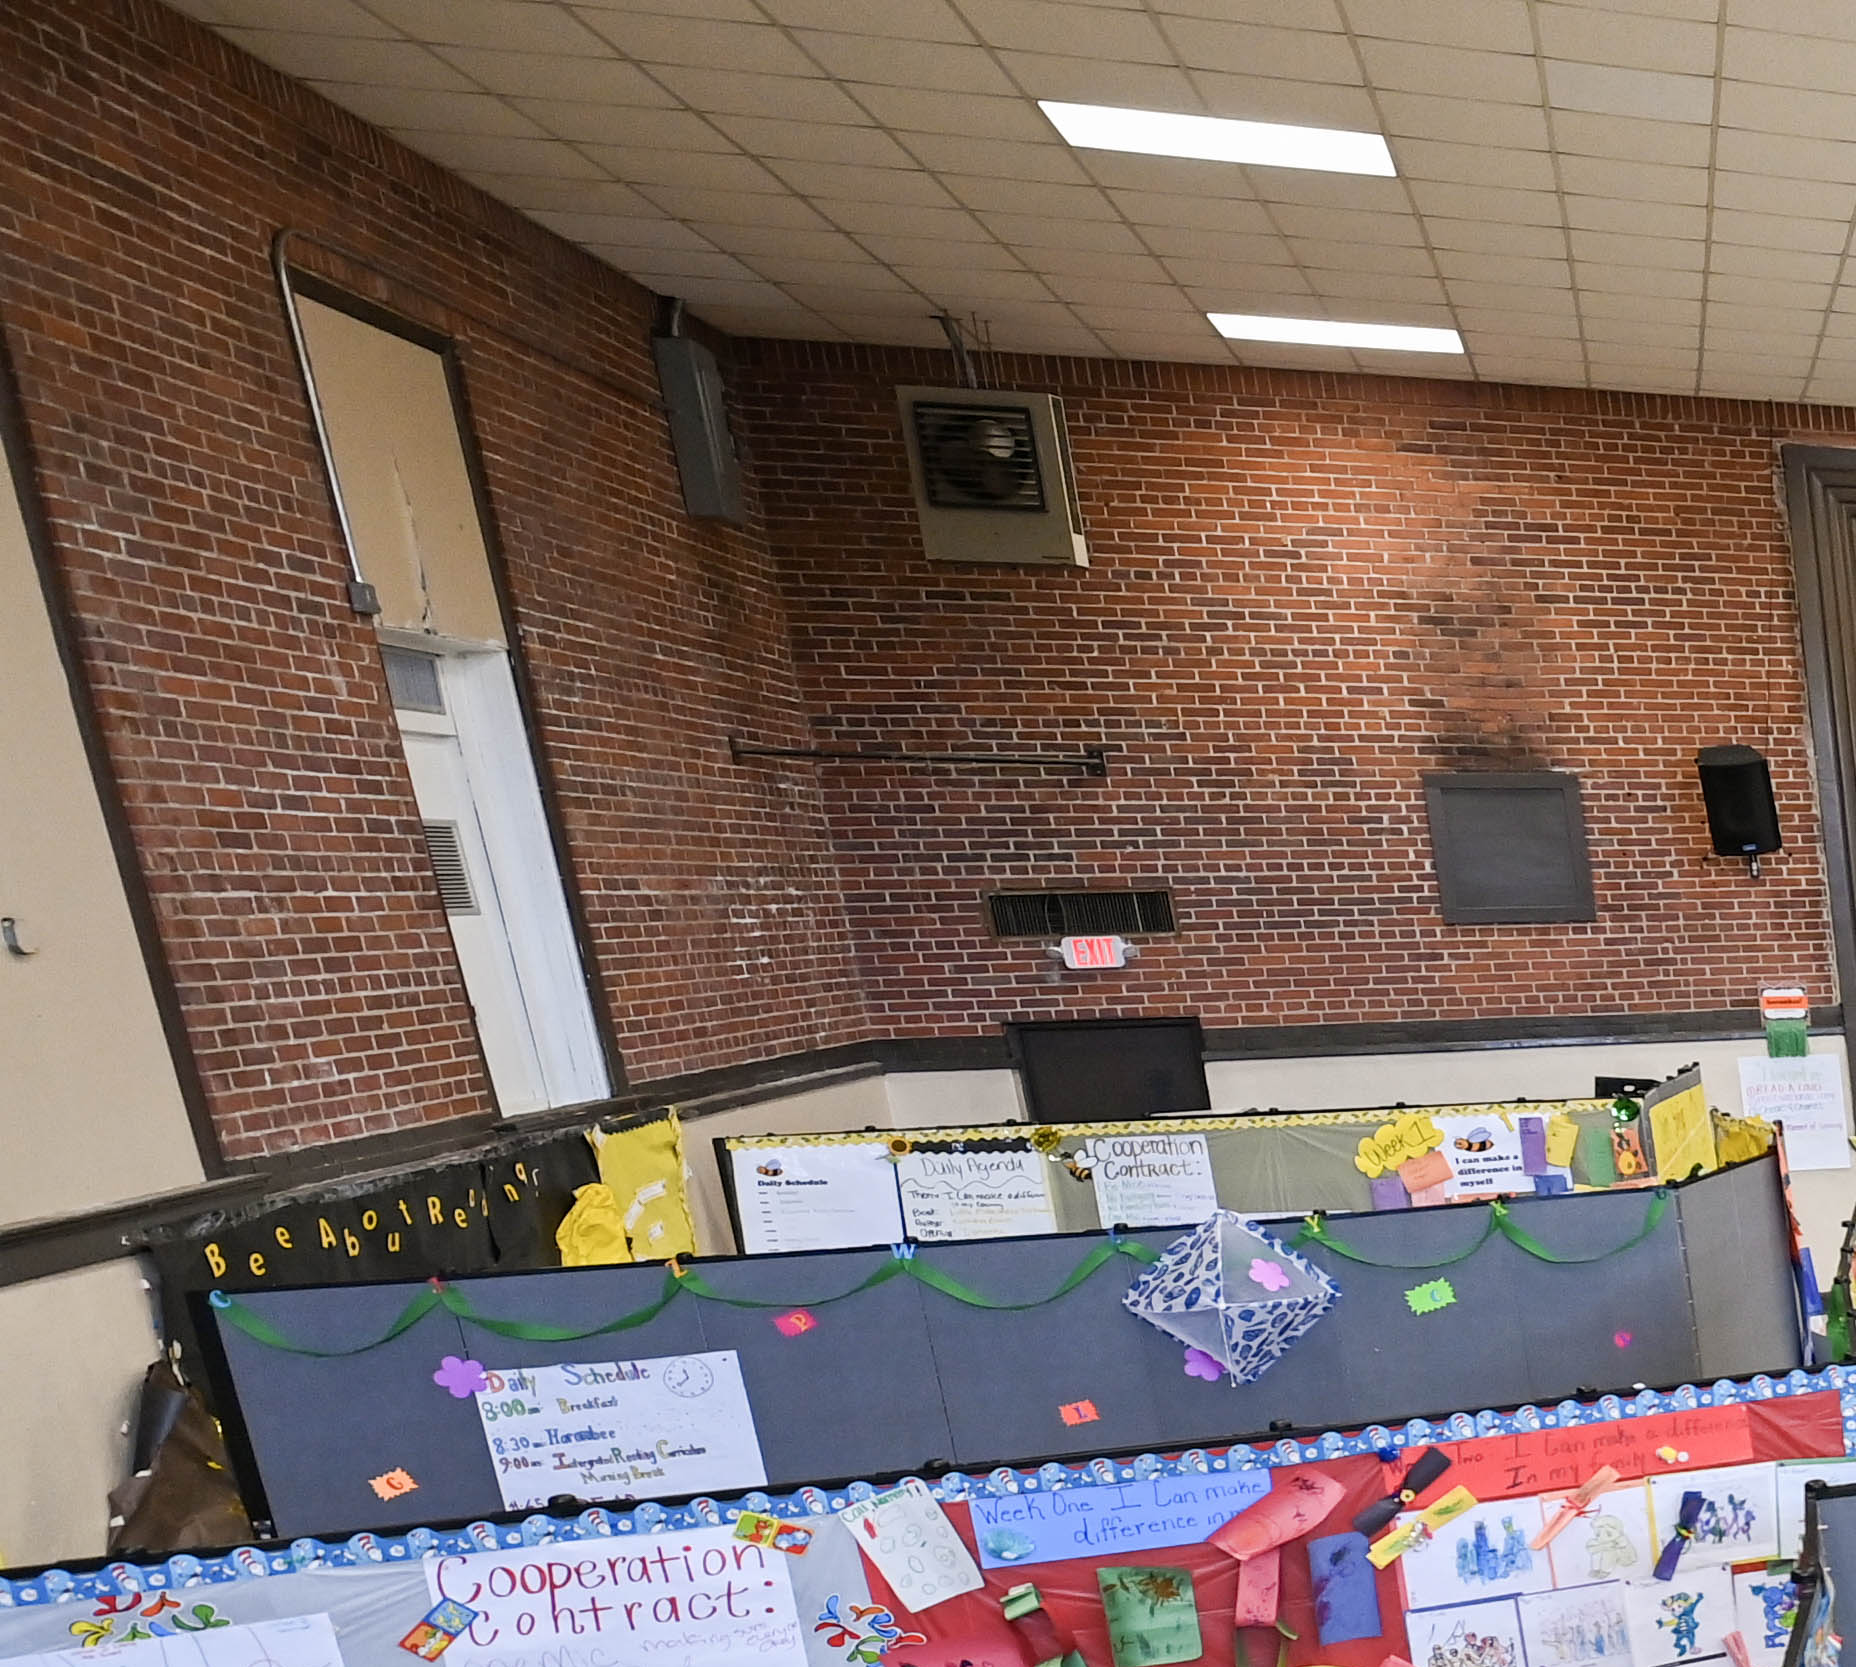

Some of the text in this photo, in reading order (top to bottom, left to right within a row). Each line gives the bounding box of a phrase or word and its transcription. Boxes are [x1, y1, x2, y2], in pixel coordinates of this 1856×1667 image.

[1072, 937, 1116, 966] EXIT
[1093, 1137, 1204, 1164] Cooperation
[1364, 1135, 1405, 1167] Week
[921, 1156, 1025, 1180] Daily Agenda
[204, 1226, 293, 1278] Bee
[318, 1199, 413, 1257] About
[487, 1362, 651, 1397] Daily Schedule
[556, 1395, 619, 1414] Breakfast
[976, 1479, 1265, 1524] Week One I Can make
[1073, 1515, 1198, 1547] difference
[438, 1544, 765, 1605] Cooperation
[469, 1580, 775, 1647] Contract:
